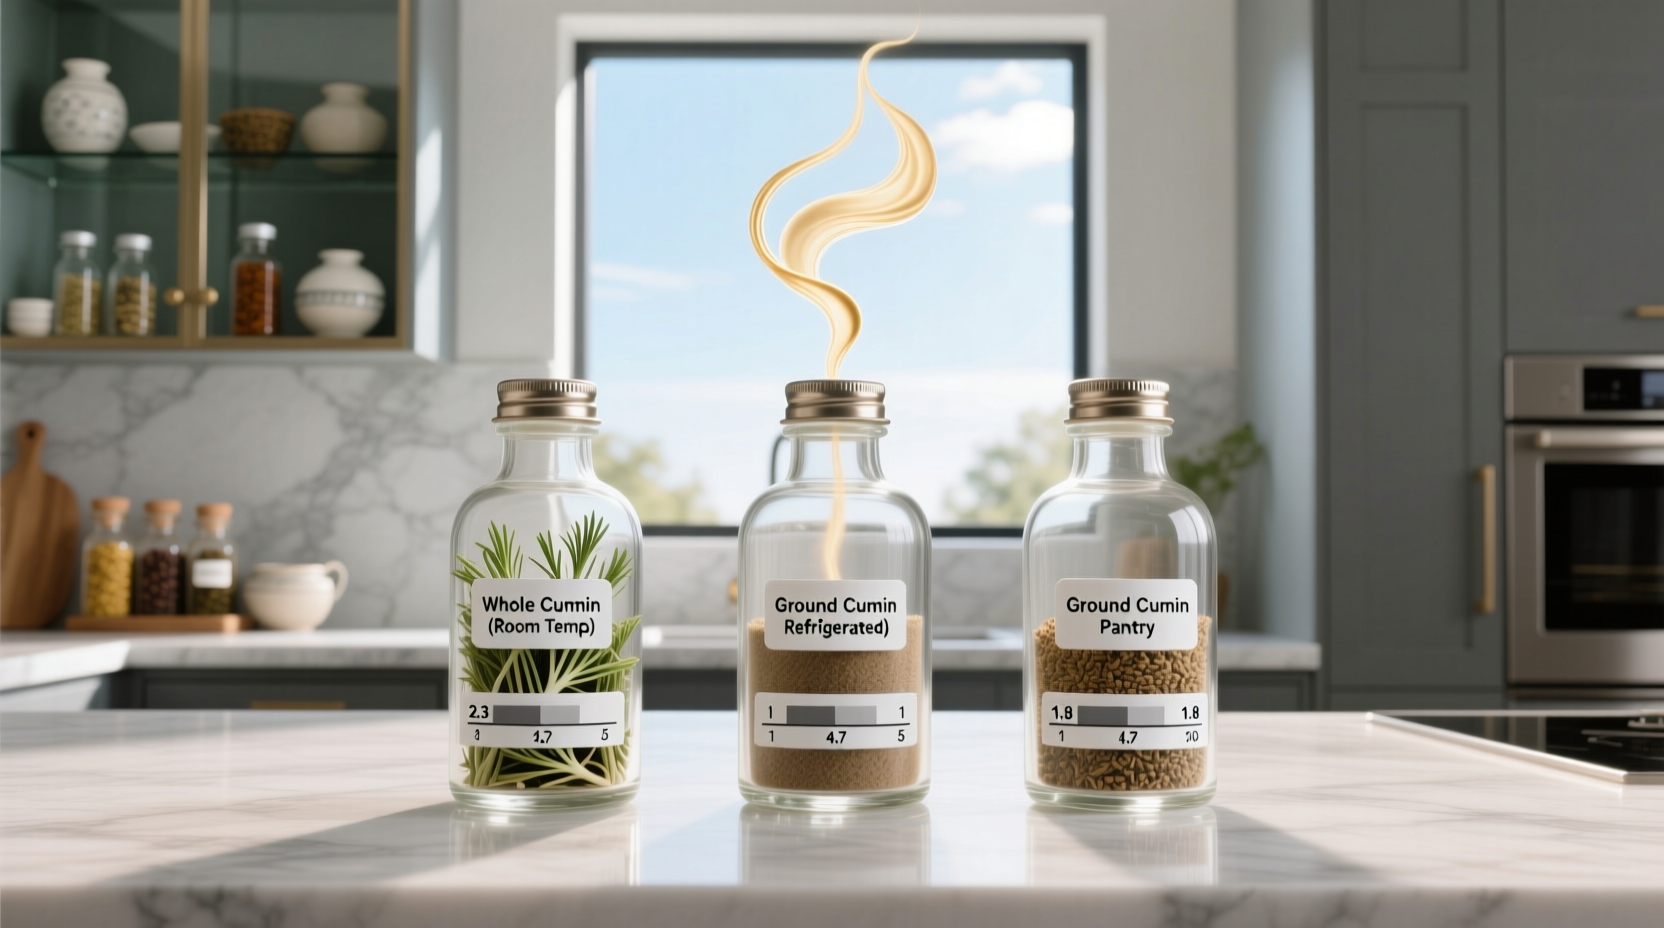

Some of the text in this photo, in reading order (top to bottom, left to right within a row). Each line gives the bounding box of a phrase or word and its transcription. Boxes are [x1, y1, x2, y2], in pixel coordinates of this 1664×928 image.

[481, 595, 536, 613] Whole
[774, 596, 897, 614] Ground Cumin
[1066, 596, 1189, 614] Ground Cumin
[488, 616, 595, 638] (Room Temp)
[784, 617, 889, 640] Refrigerated)
[1100, 618, 1155, 640] Pantry
[468, 704, 490, 719] 2.3
[767, 705, 774, 720] 1
[898, 705, 905, 719] 1
[1181, 705, 1200, 720] 1.8
[767, 729, 905, 745] 1 4.7 5
[1057, 729, 1065, 742] 1
[1118, 730, 1138, 745] 4.7
